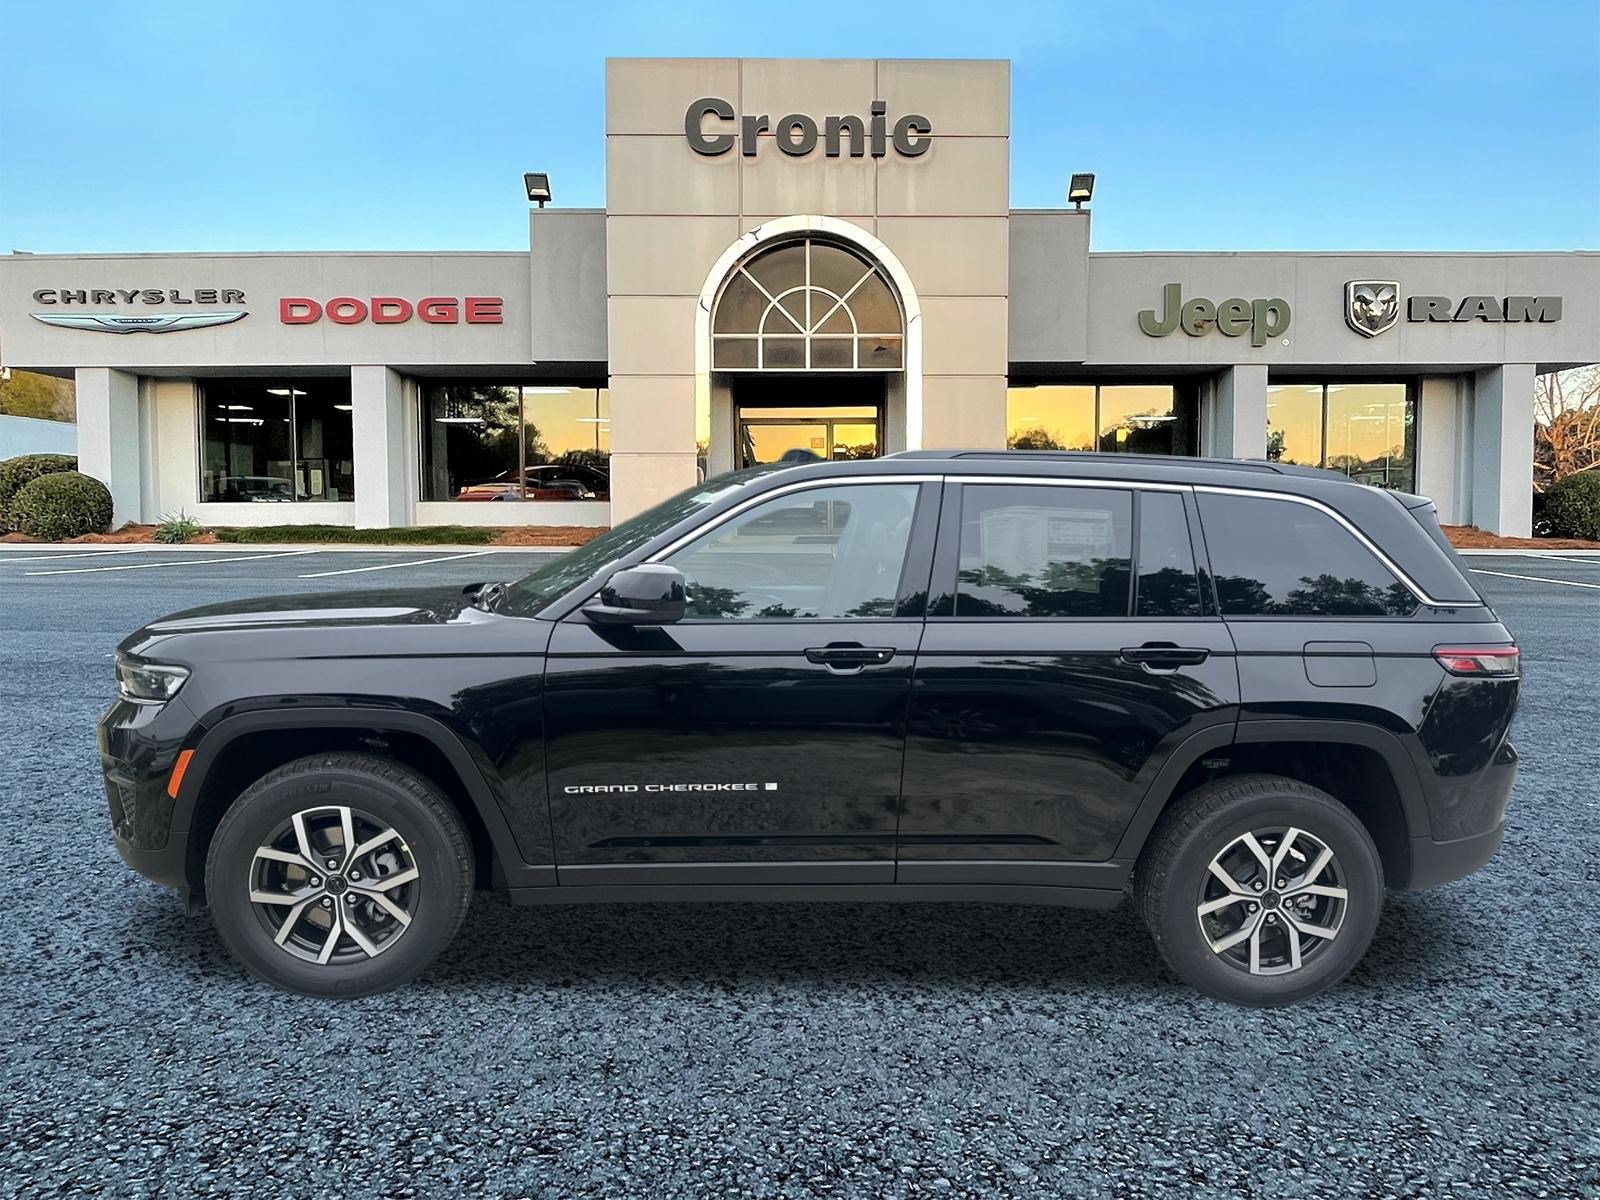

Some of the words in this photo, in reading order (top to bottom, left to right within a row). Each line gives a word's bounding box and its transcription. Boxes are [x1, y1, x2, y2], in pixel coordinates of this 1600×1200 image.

[685, 97, 932, 158] Cronic
[32, 289, 247, 304] CHRYSLER
[1407, 296, 1563, 323] RAM
[280, 297, 504, 325] DODGE
[1138, 283, 1291, 347] Jeep
[564, 784, 639, 794] GRAND
[645, 783, 759, 793] CHEROKEE
